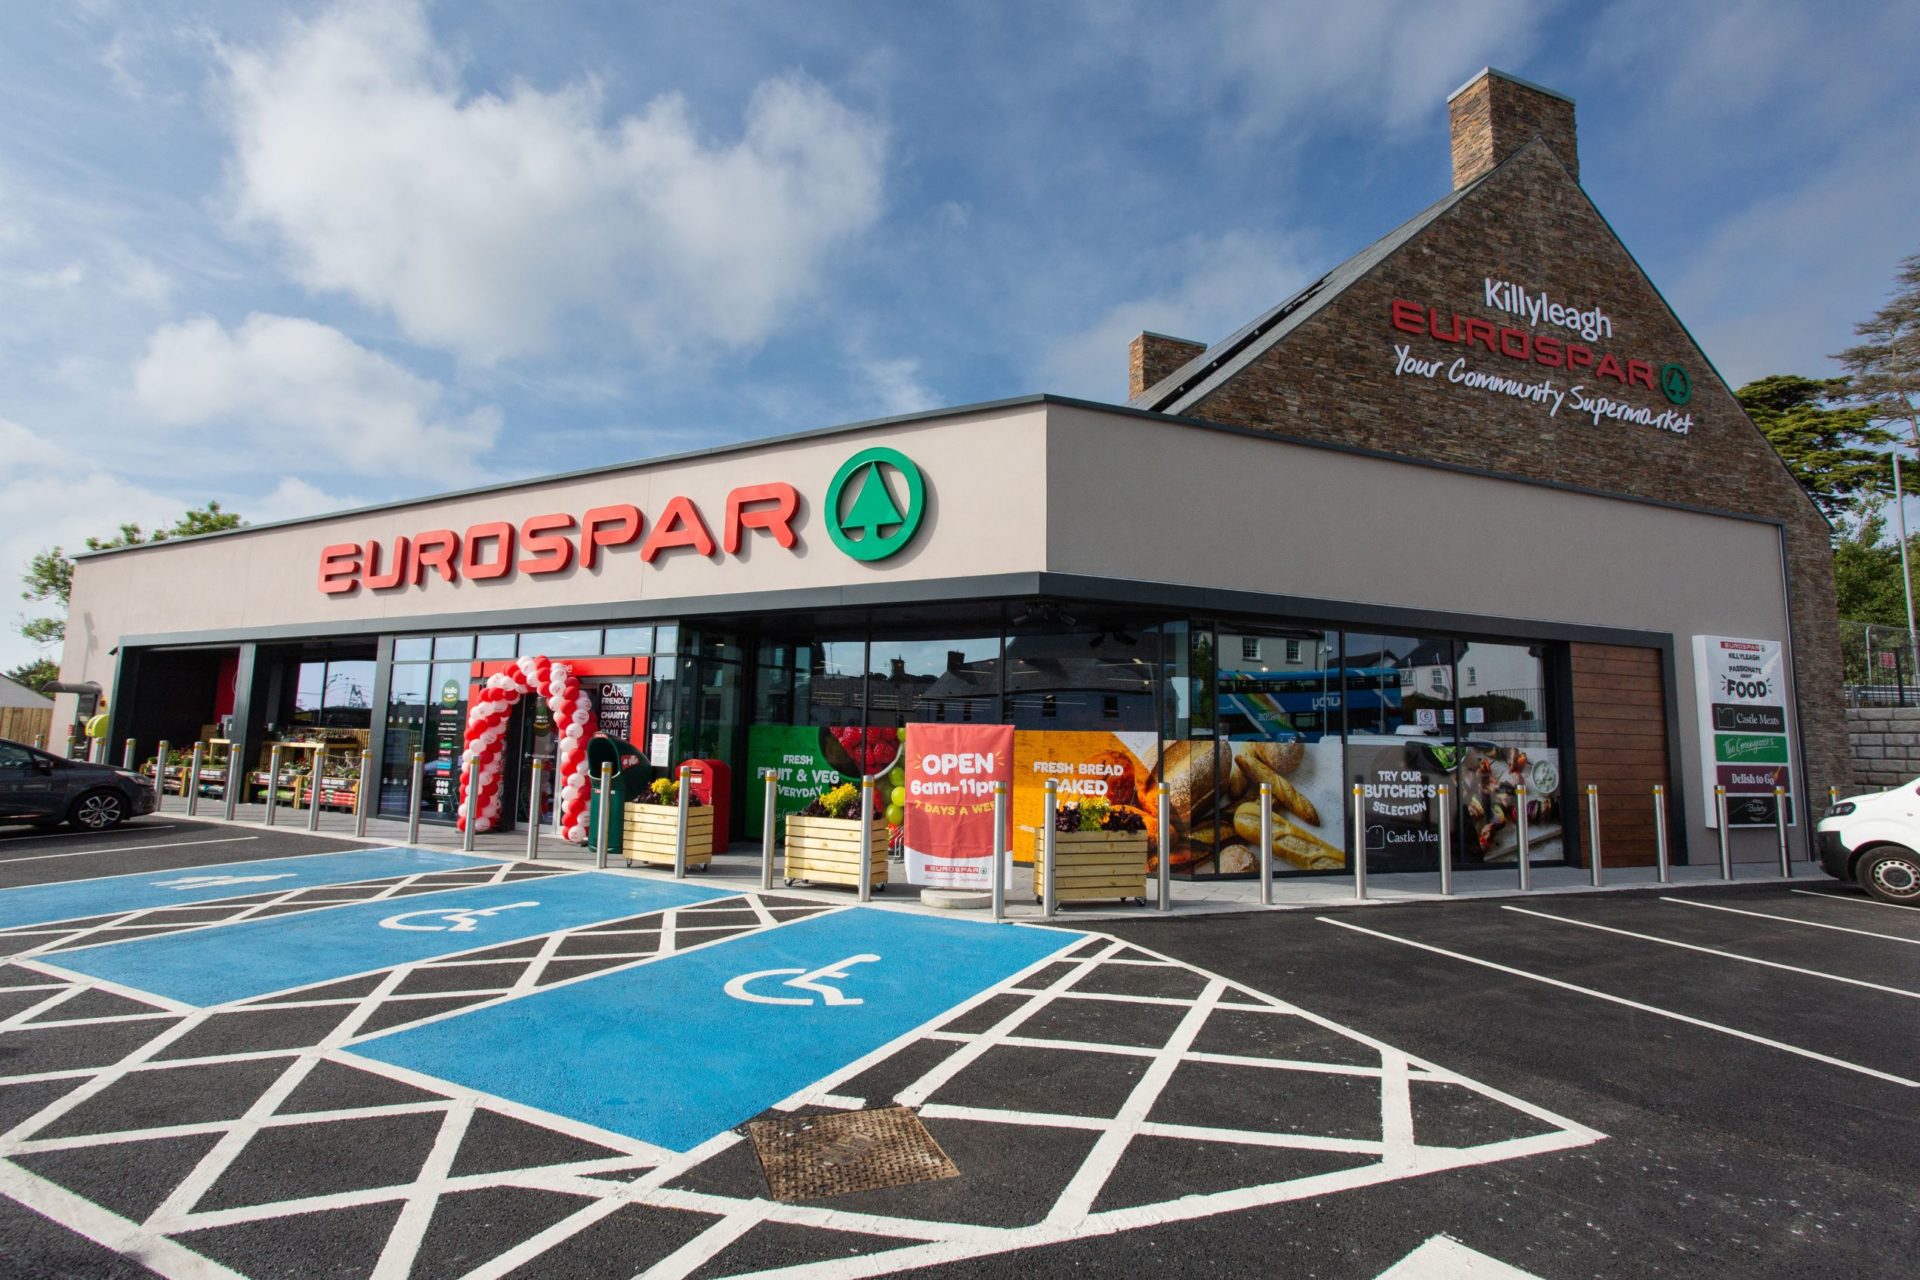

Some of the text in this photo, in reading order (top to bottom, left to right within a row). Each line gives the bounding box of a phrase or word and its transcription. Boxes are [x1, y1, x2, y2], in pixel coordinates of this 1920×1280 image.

[1484, 277, 1612, 342] Killyleagh
[1391, 299, 1655, 390] EUROSPAR
[1394, 344, 1694, 435] Your Community Supermarket
[317, 481, 801, 595] EUROSPAR
[1728, 652, 1761, 661] KILLYLEAGH
[602, 684, 630, 697] CARE
[1727, 679, 1767, 698] FOOD
[601, 711, 629, 719] CHARITY
[1736, 713, 1780, 725] Castle Meats
[600, 720, 628, 728] DONATE
[783, 754, 814, 765] FRESH
[922, 752, 994, 776] OPEN
[757, 766, 840, 784] FIT & VEG
[1033, 761, 1124, 776] FRESH BREAD
[1378, 770, 1422, 782] TRY OUR
[1731, 773, 1775, 785] Delish to Go
[777, 784, 822, 798] VERYDAY
[1364, 784, 1436, 798] BUTCHER'S
[925, 802, 956, 815] DAYS
[960, 806, 968, 816] A
[972, 800, 995, 814] WE
[1372, 801, 1427, 816] SELECTION
[1386, 829, 1439, 843] Castle Mea
